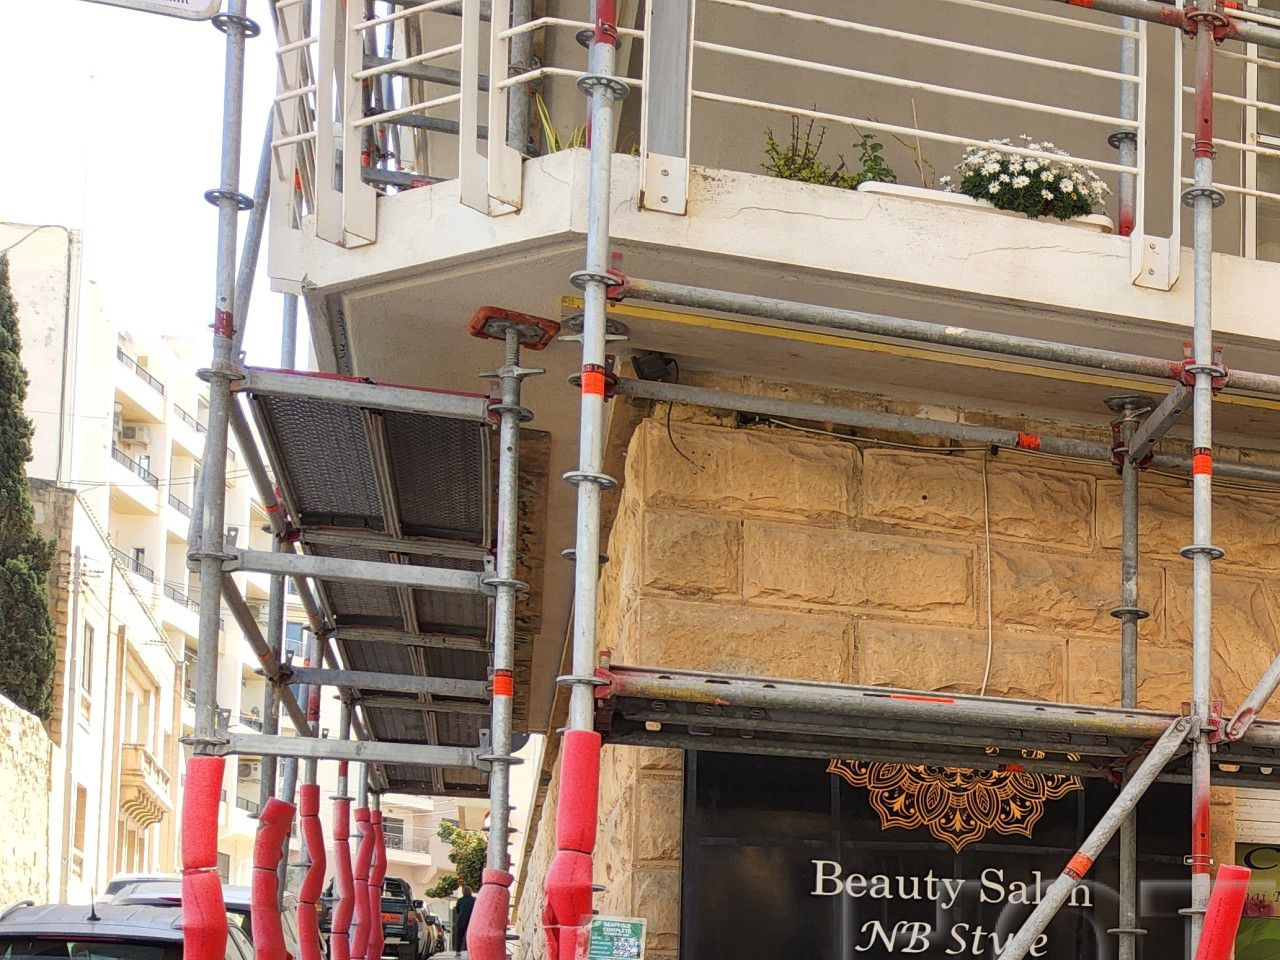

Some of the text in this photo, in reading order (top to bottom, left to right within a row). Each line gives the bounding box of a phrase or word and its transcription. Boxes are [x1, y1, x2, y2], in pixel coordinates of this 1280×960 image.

[810, 860, 1093, 910] Beauty Saln
[854, 920, 932, 954] NB
